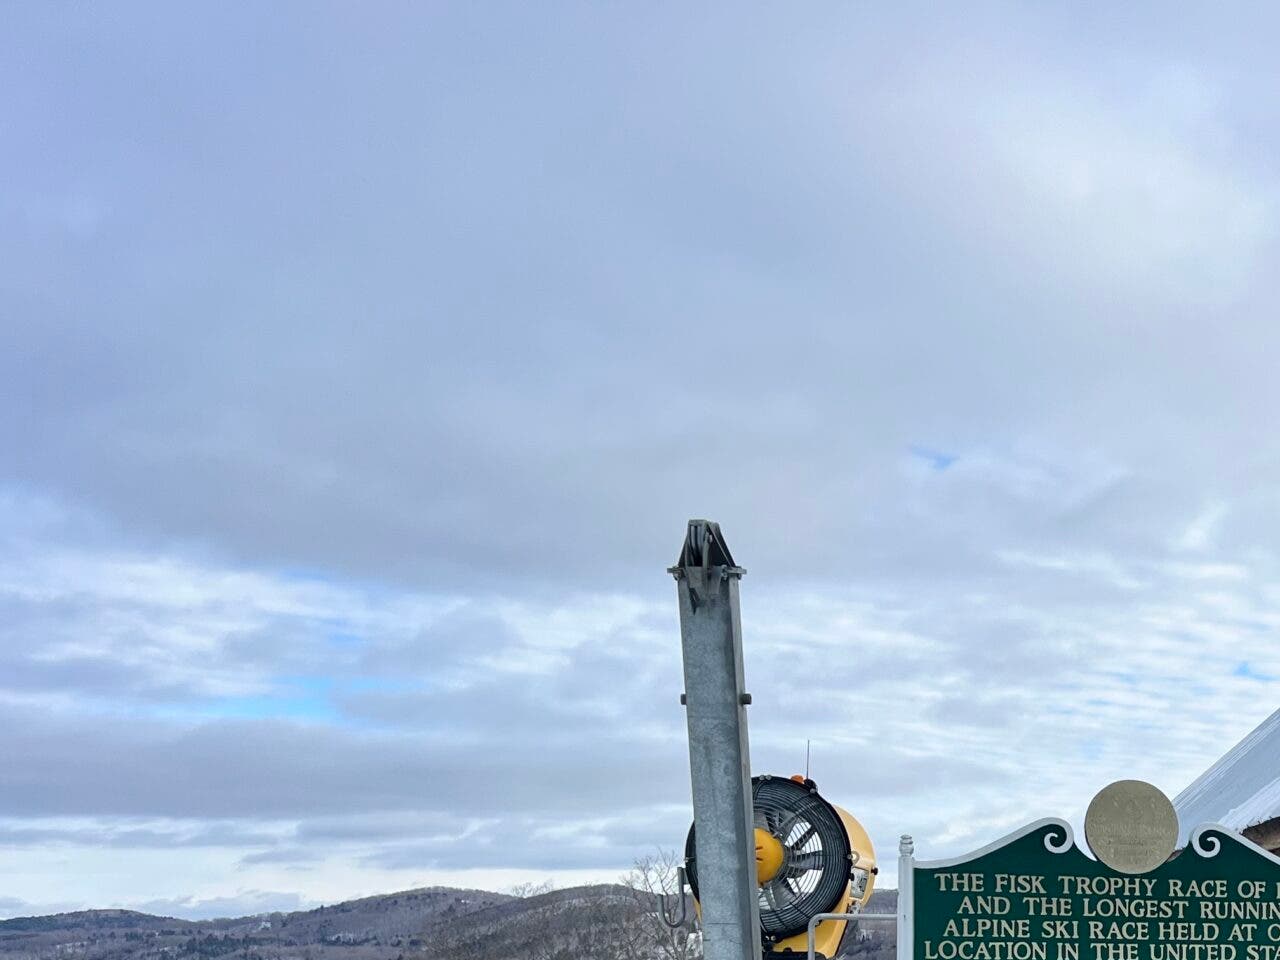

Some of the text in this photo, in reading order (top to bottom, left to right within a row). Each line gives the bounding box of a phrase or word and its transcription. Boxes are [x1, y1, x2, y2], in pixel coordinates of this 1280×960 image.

[934, 872, 983, 891] THE
[995, 874, 1046, 893] FISK
[1058, 875, 1156, 896] TROPHY
[1168, 878, 1227, 897] RACE
[1237, 880, 1265, 898] OF
[957, 895, 1010, 914] AND
[1022, 897, 1072, 916] THE
[1083, 897, 1189, 918] LONGEST
[943, 918, 1029, 938] ALPINE
[1041, 920, 1079, 938] SKI
[1088, 921, 1149, 940] RACE
[1158, 922, 1219, 940] HELD
[1227, 923, 1257, 941] AT
[924, 940, 1046, 960] LOCATION
[1057, 942, 1078, 960] IN
[1090, 942, 1138, 960] THE
